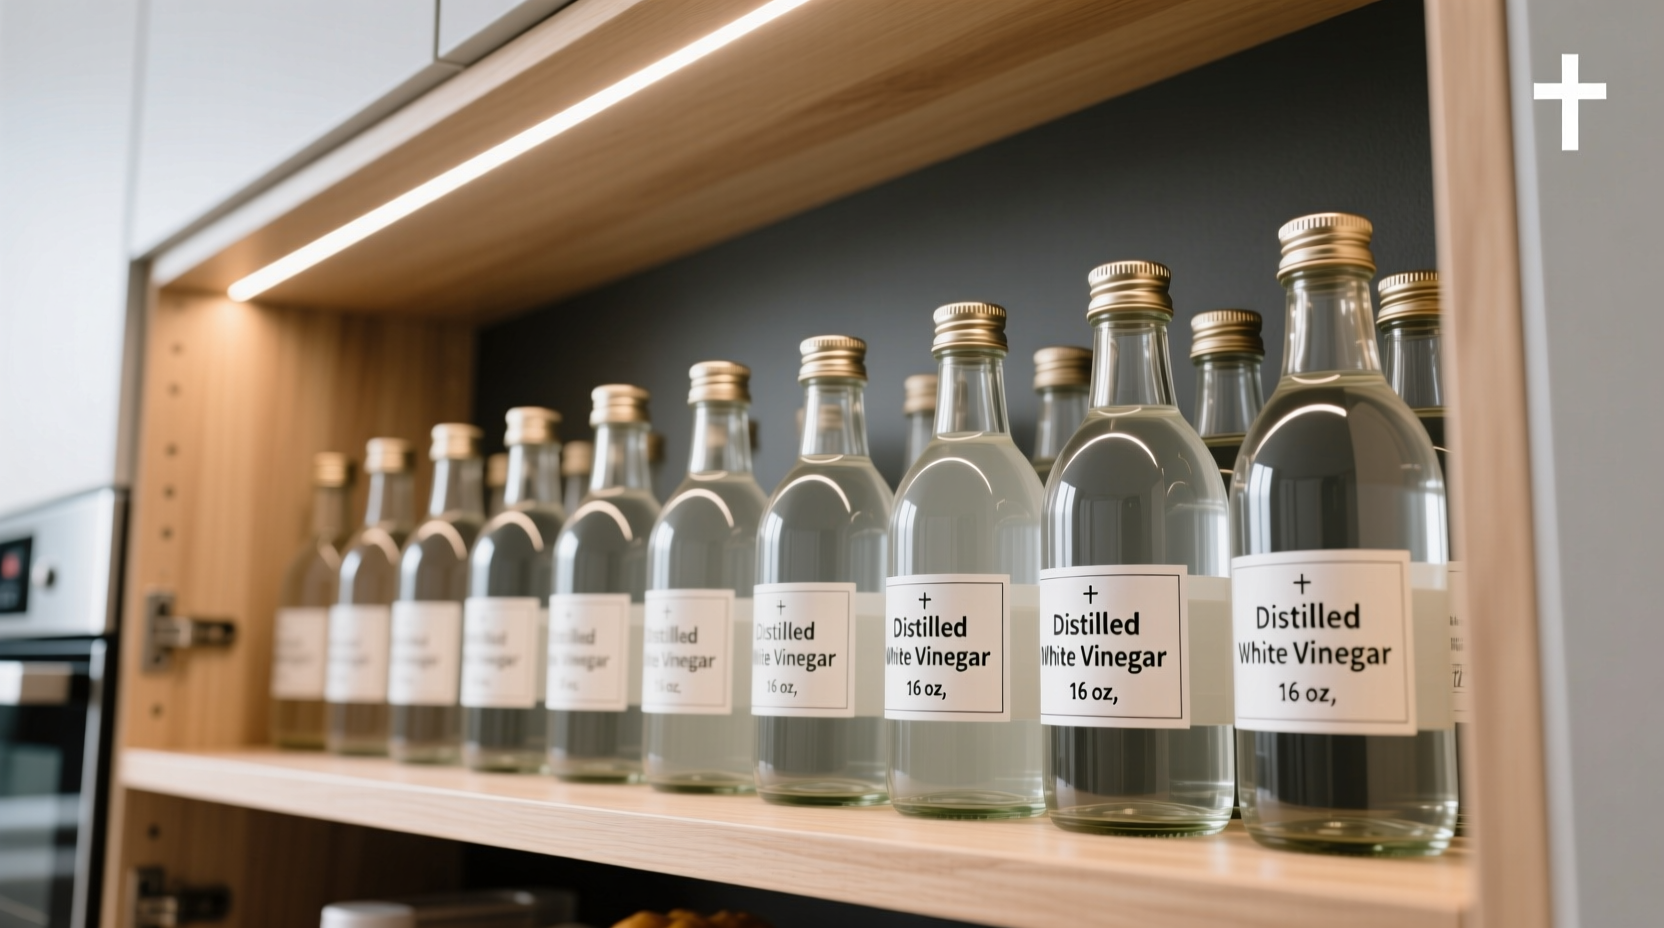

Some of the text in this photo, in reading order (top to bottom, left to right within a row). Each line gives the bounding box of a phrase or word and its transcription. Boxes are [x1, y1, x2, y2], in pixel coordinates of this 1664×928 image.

[893, 615, 967, 638] Distilled
[1053, 611, 1140, 636] Distilled
[1256, 602, 1360, 629] Distilled
[774, 648, 837, 672] Vinegar
[915, 646, 991, 672] Vinegar
[1080, 644, 1167, 674] Vinegar
[1238, 640, 1392, 672] White Vinegar
[780, 682, 798, 698] oz,
[906, 679, 947, 701] 16 oz,
[1069, 681, 1118, 705] 16 oz,
[1278, 681, 1337, 707] 16 oz,
